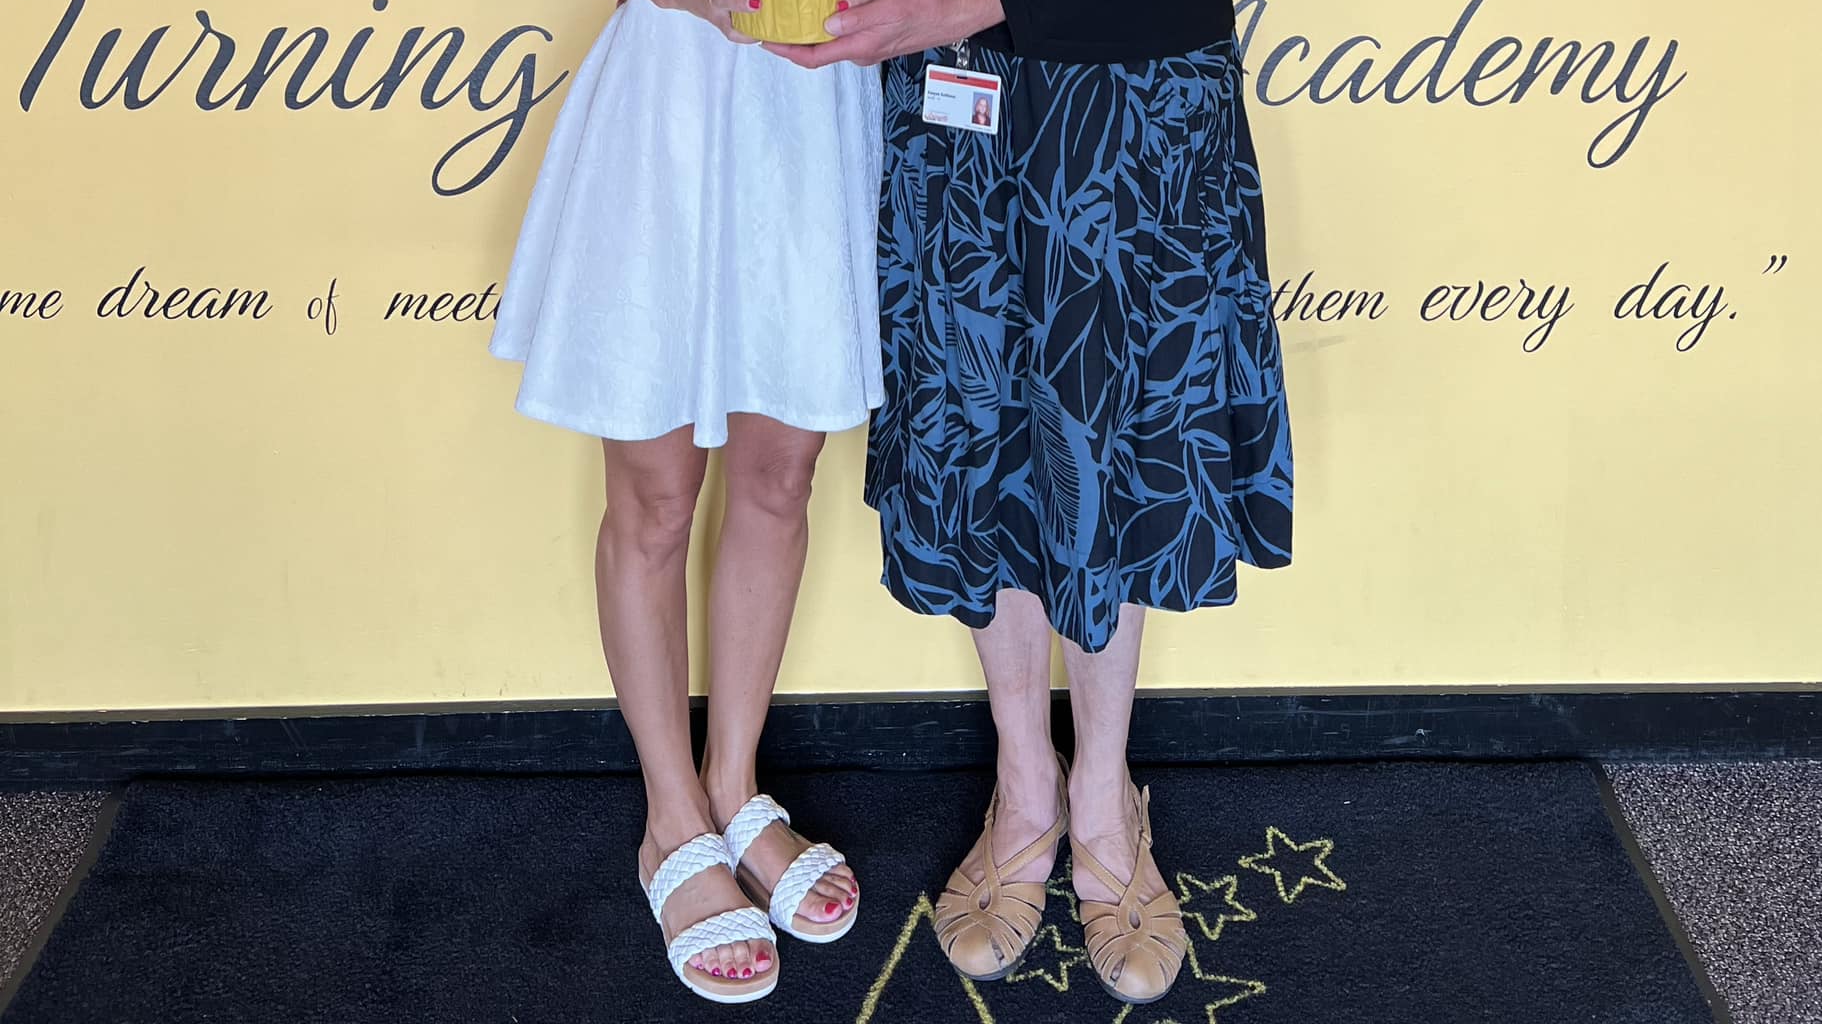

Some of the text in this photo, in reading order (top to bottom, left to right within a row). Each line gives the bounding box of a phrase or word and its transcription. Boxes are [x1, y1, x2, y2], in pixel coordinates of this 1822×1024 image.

[97, 266, 272, 321] dream
[307, 278, 338, 336] of
[1271, 270, 1388, 322] them
[1420, 278, 1575, 353] every
